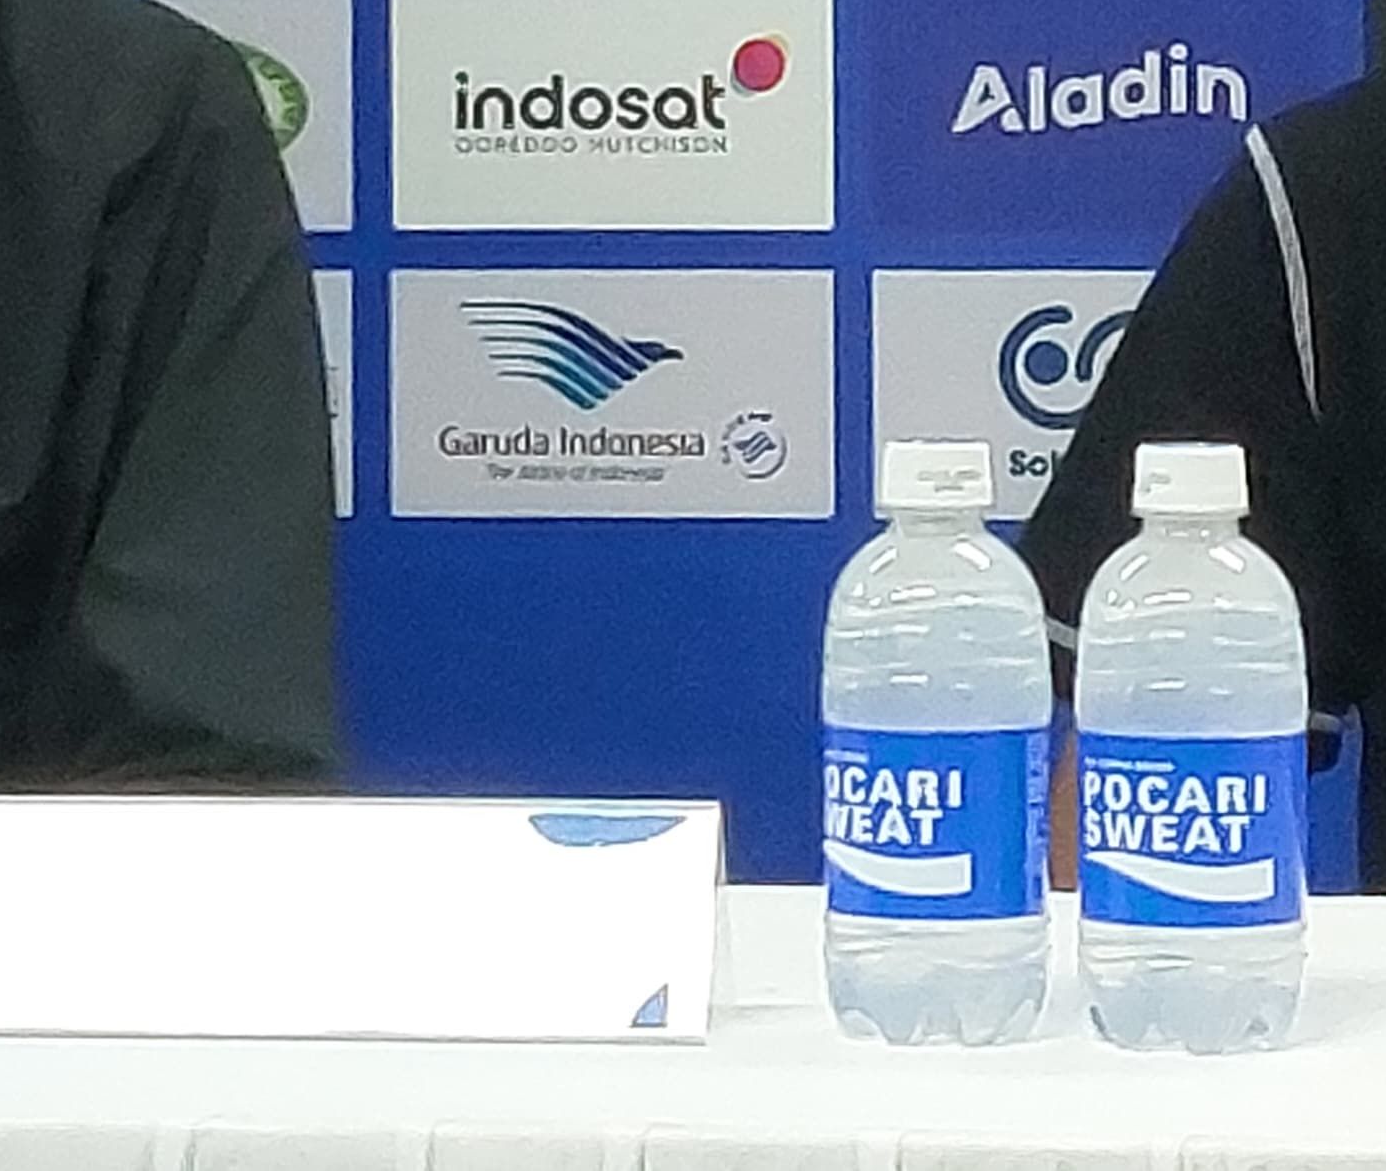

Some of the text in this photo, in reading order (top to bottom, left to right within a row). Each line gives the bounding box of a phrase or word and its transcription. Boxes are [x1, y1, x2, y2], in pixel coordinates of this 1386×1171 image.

[455, 71, 725, 129] indosat
[952, 43, 1247, 133] Aladin
[438, 425, 550, 457] Garuda
[560, 425, 705, 457] Indonesia
[824, 764, 962, 809] OCARI
[1084, 770, 1267, 814] POCARI
[1084, 808, 1250, 854] SWEAT
